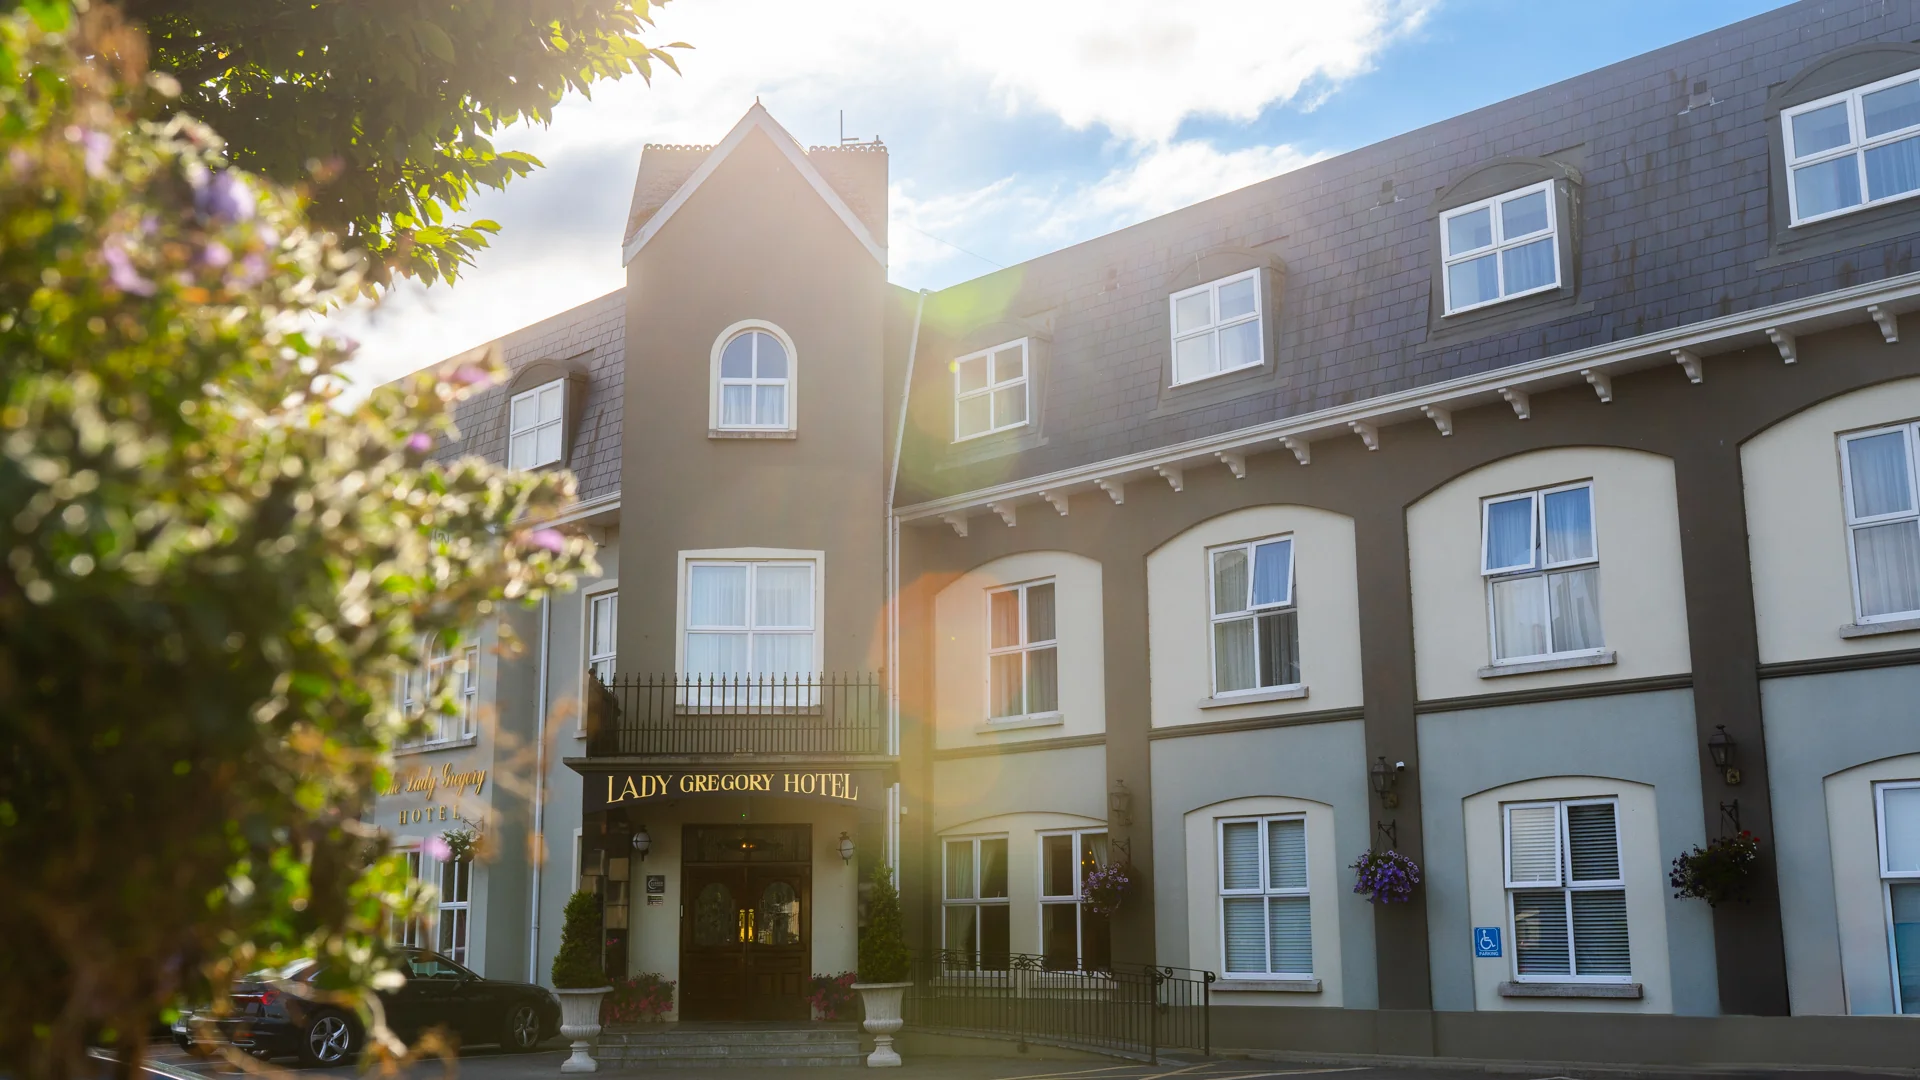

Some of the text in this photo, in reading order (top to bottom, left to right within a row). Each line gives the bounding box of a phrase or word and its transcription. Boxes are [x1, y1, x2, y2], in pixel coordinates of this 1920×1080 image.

[405, 766, 437, 800] Lady
[442, 762, 486, 796] Gregory
[606, 773, 859, 804] LADY GREGORY HOTEL
[398, 804, 460, 824] HOTEL
